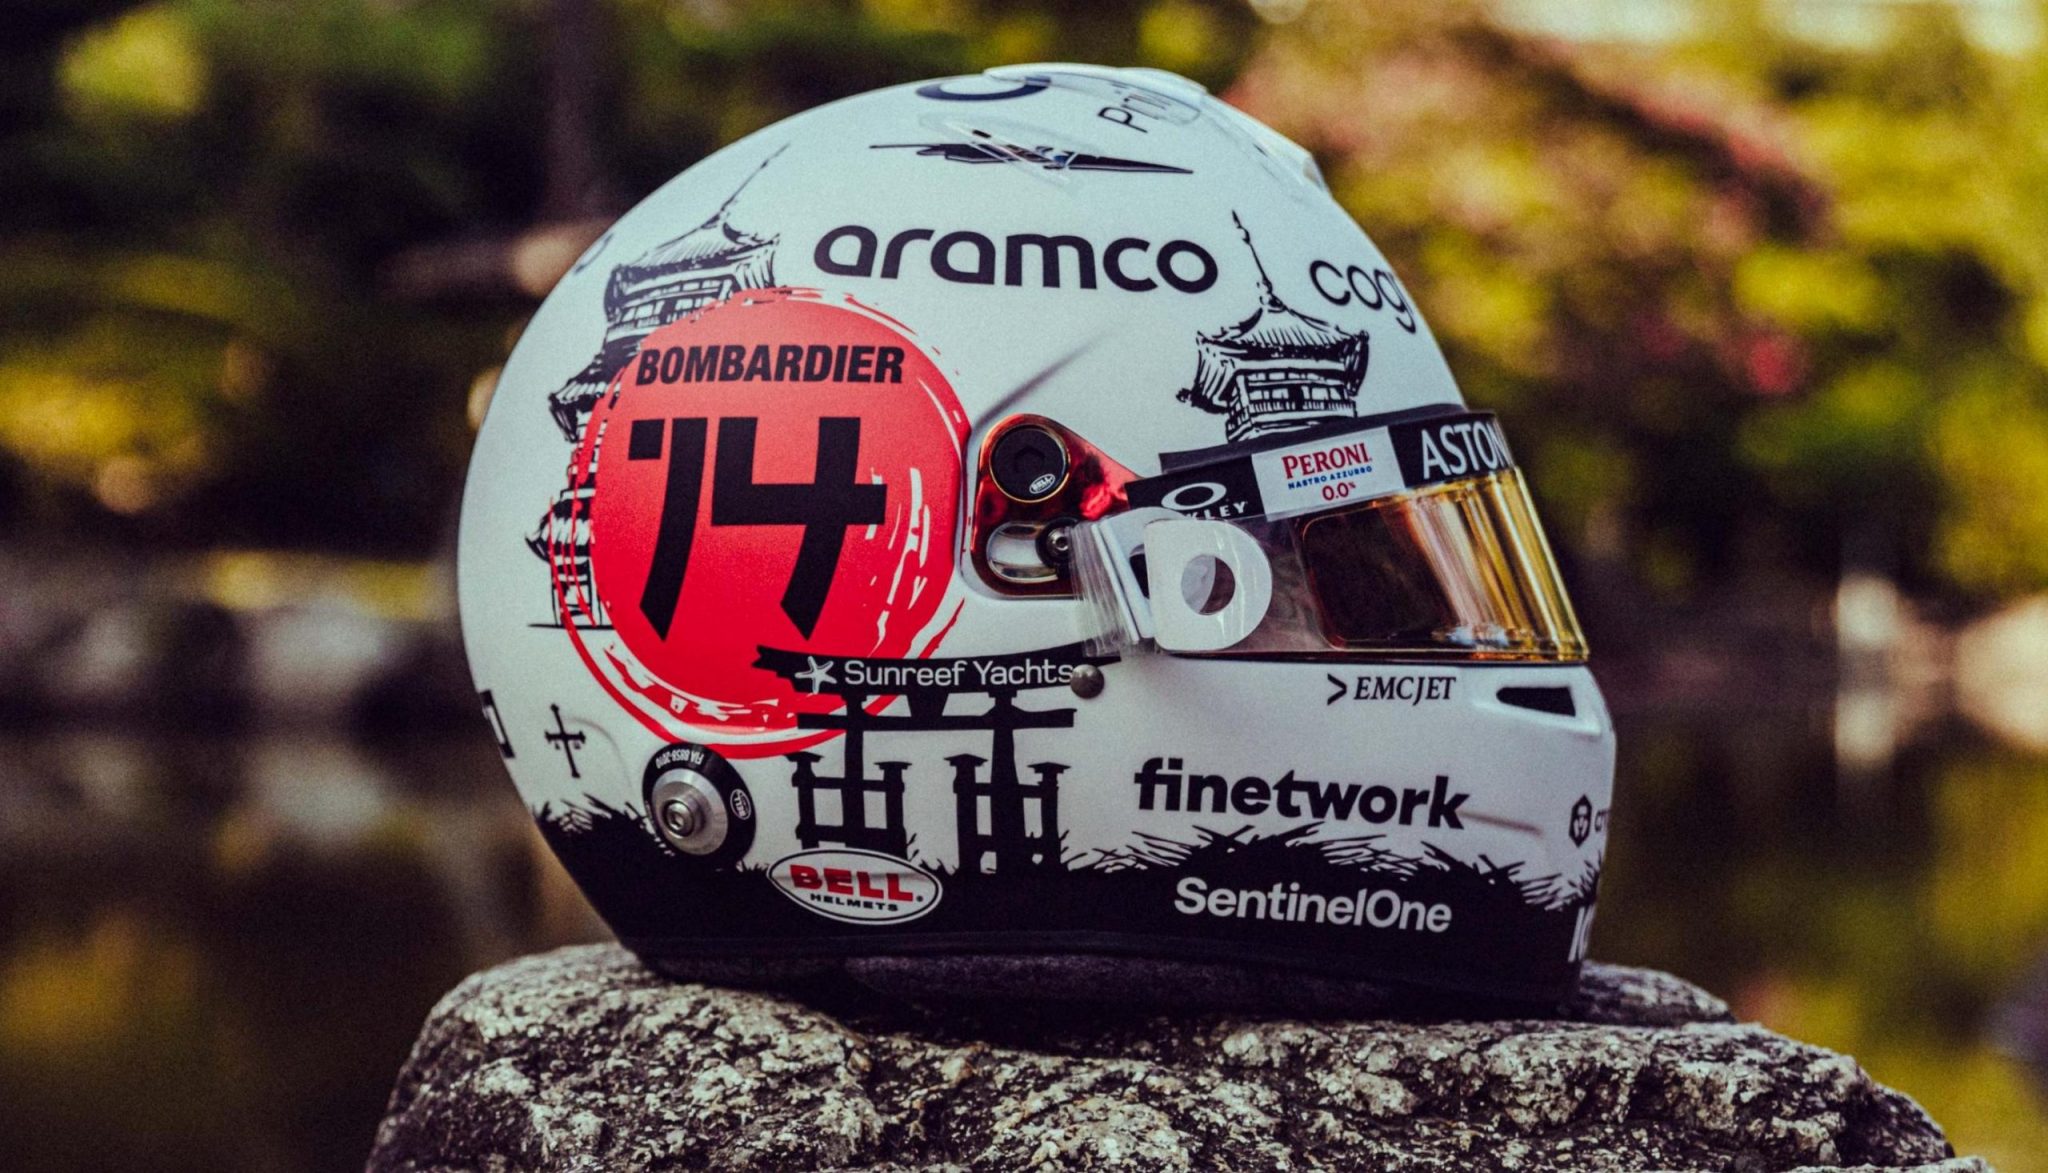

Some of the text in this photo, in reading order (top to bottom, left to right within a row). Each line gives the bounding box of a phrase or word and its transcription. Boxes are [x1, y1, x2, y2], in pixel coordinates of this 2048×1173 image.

[813, 224, 1219, 294] aramco
[635, 343, 906, 387] BOMBARDIER
[1281, 442, 1371, 479] PERONI
[1287, 465, 1373, 490] NASTRO AZZURRO
[1184, 500, 1247, 520] KLEY
[844, 657, 1073, 687] Sunreef Yachts
[1353, 675, 1457, 706] EMCJET
[1134, 756, 1471, 830] finetwork
[789, 864, 914, 903] BELL
[809, 893, 900, 912] HELMETS
[1174, 876, 1453, 933] SentinelOne
